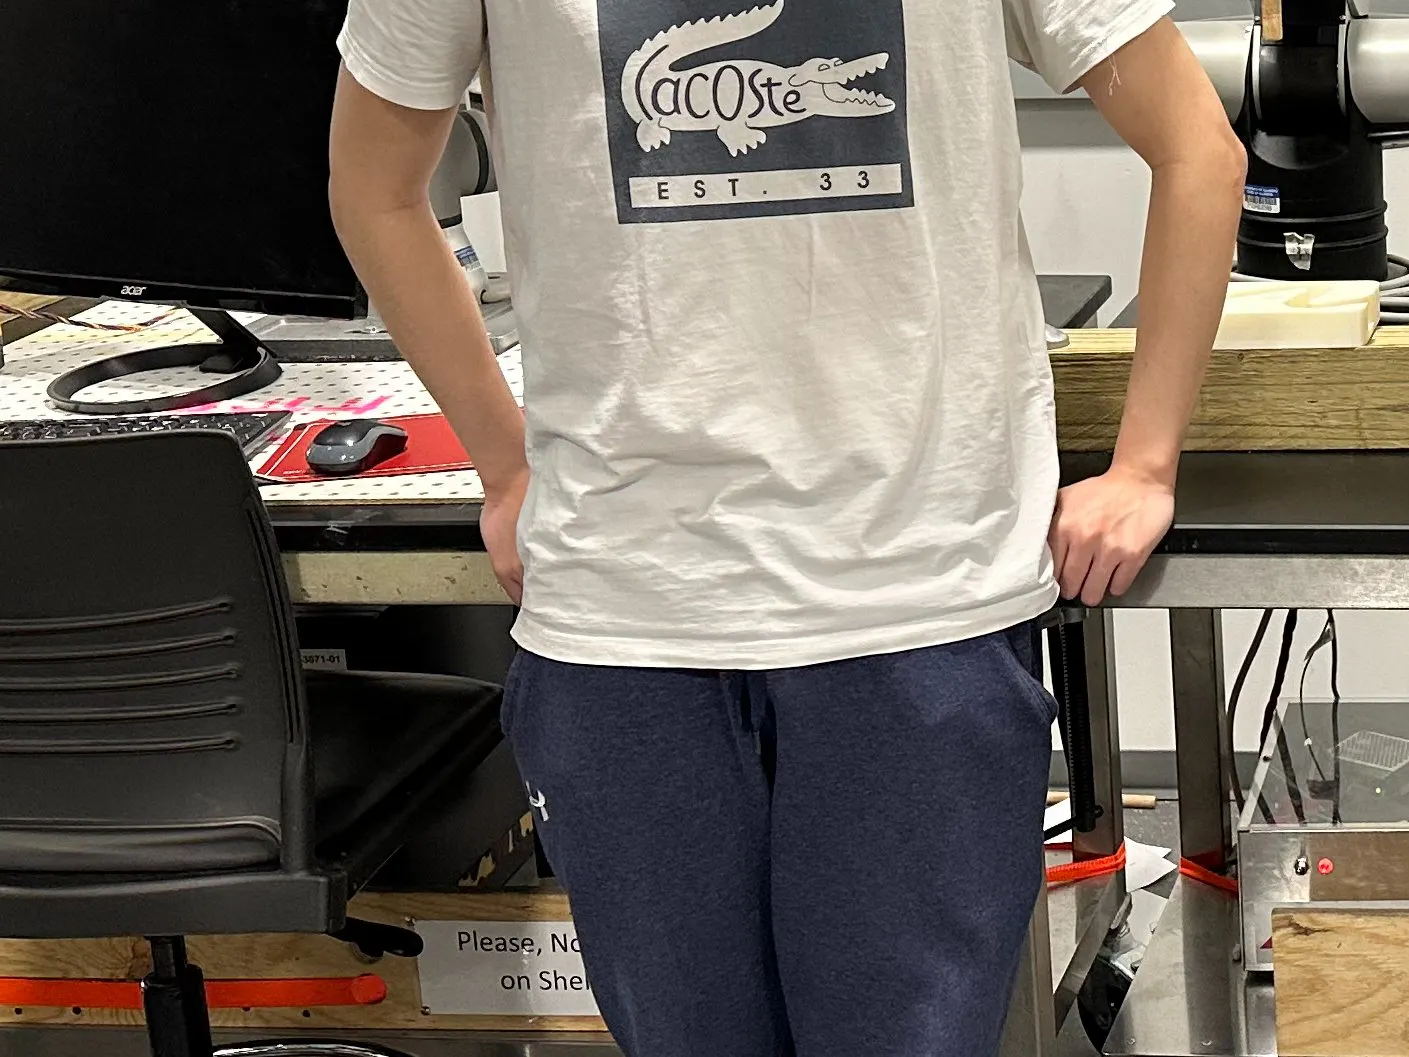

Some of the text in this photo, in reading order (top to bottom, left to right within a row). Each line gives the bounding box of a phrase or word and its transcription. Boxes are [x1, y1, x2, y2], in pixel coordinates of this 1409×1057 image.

[657, 170, 870, 200] EST. 33
[120, 285, 147, 295] acer
[457, 930, 542, 956] Please,
[501, 974, 531, 990] on
